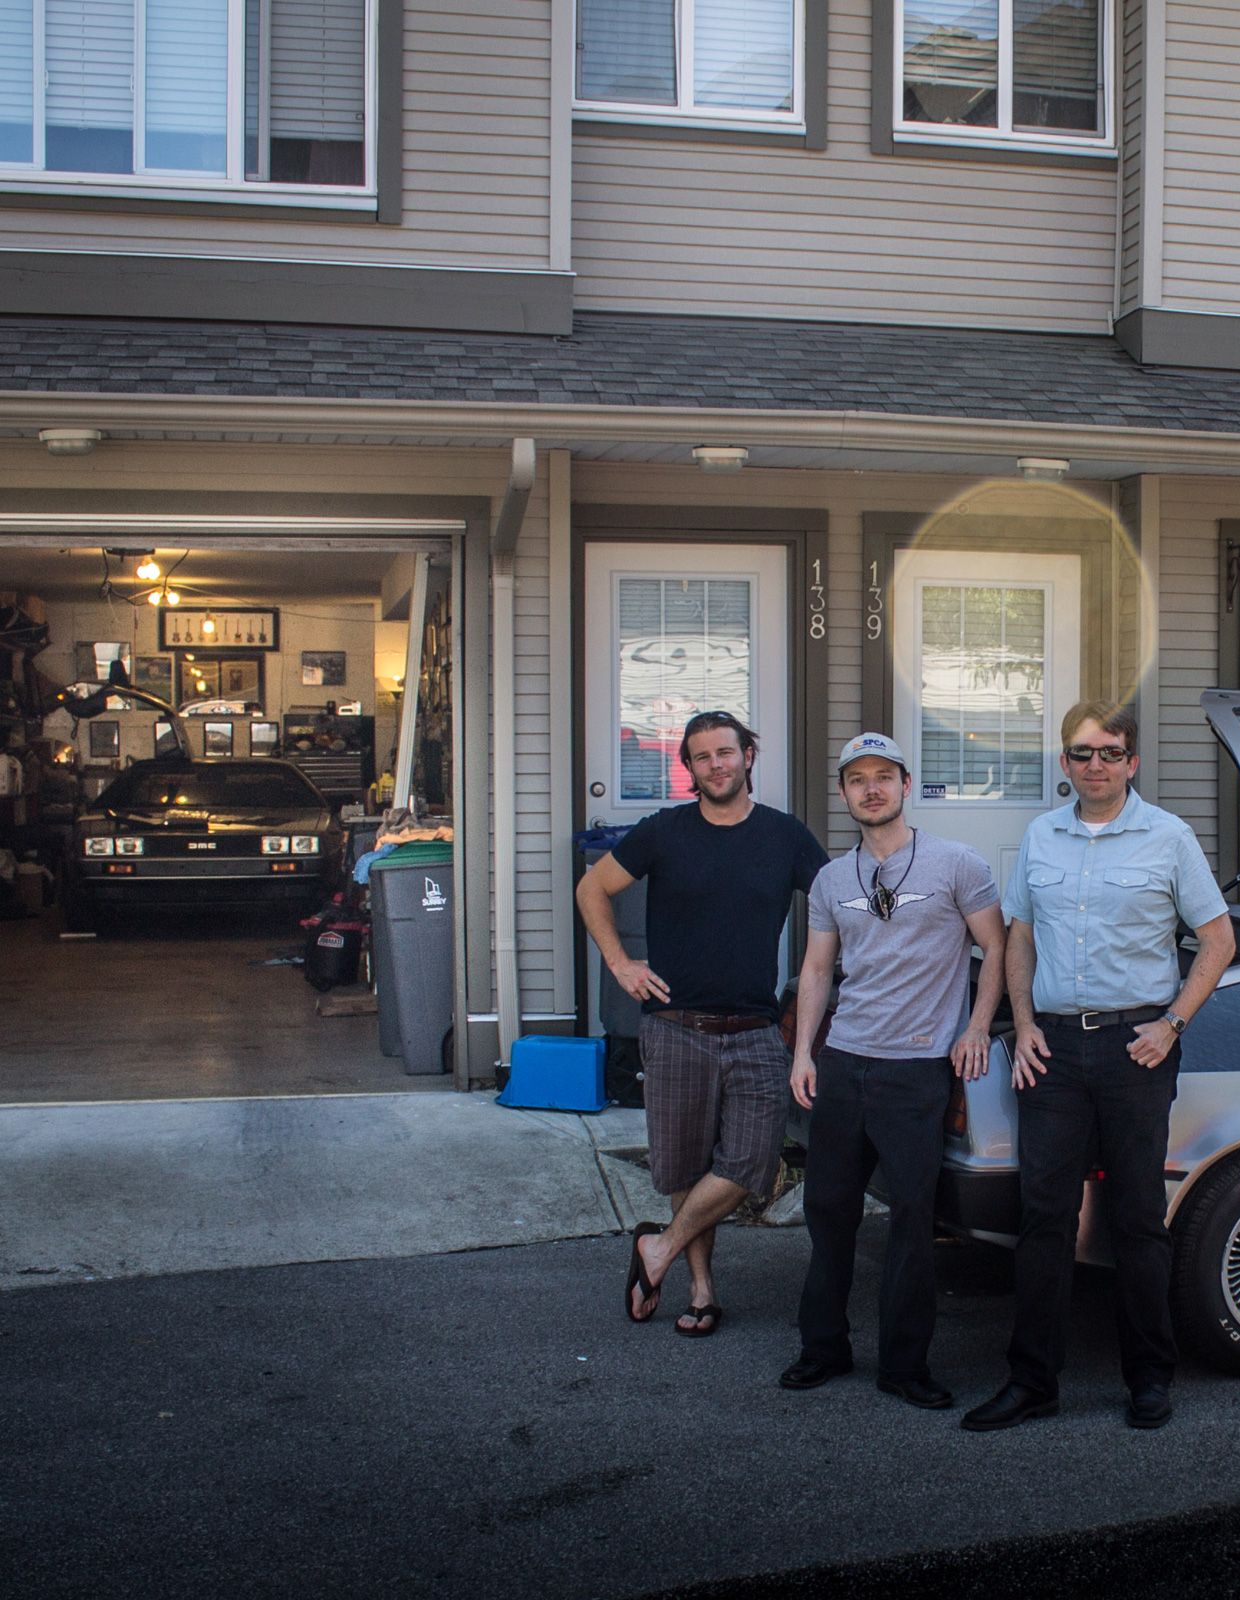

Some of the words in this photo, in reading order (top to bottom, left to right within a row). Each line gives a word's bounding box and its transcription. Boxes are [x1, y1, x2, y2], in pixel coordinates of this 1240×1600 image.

[810, 559, 825, 639] 138
[867, 560, 882, 640] 139
[863, 738, 887, 748] SPCA
[1219, 1317, 1240, 1342] G/T
